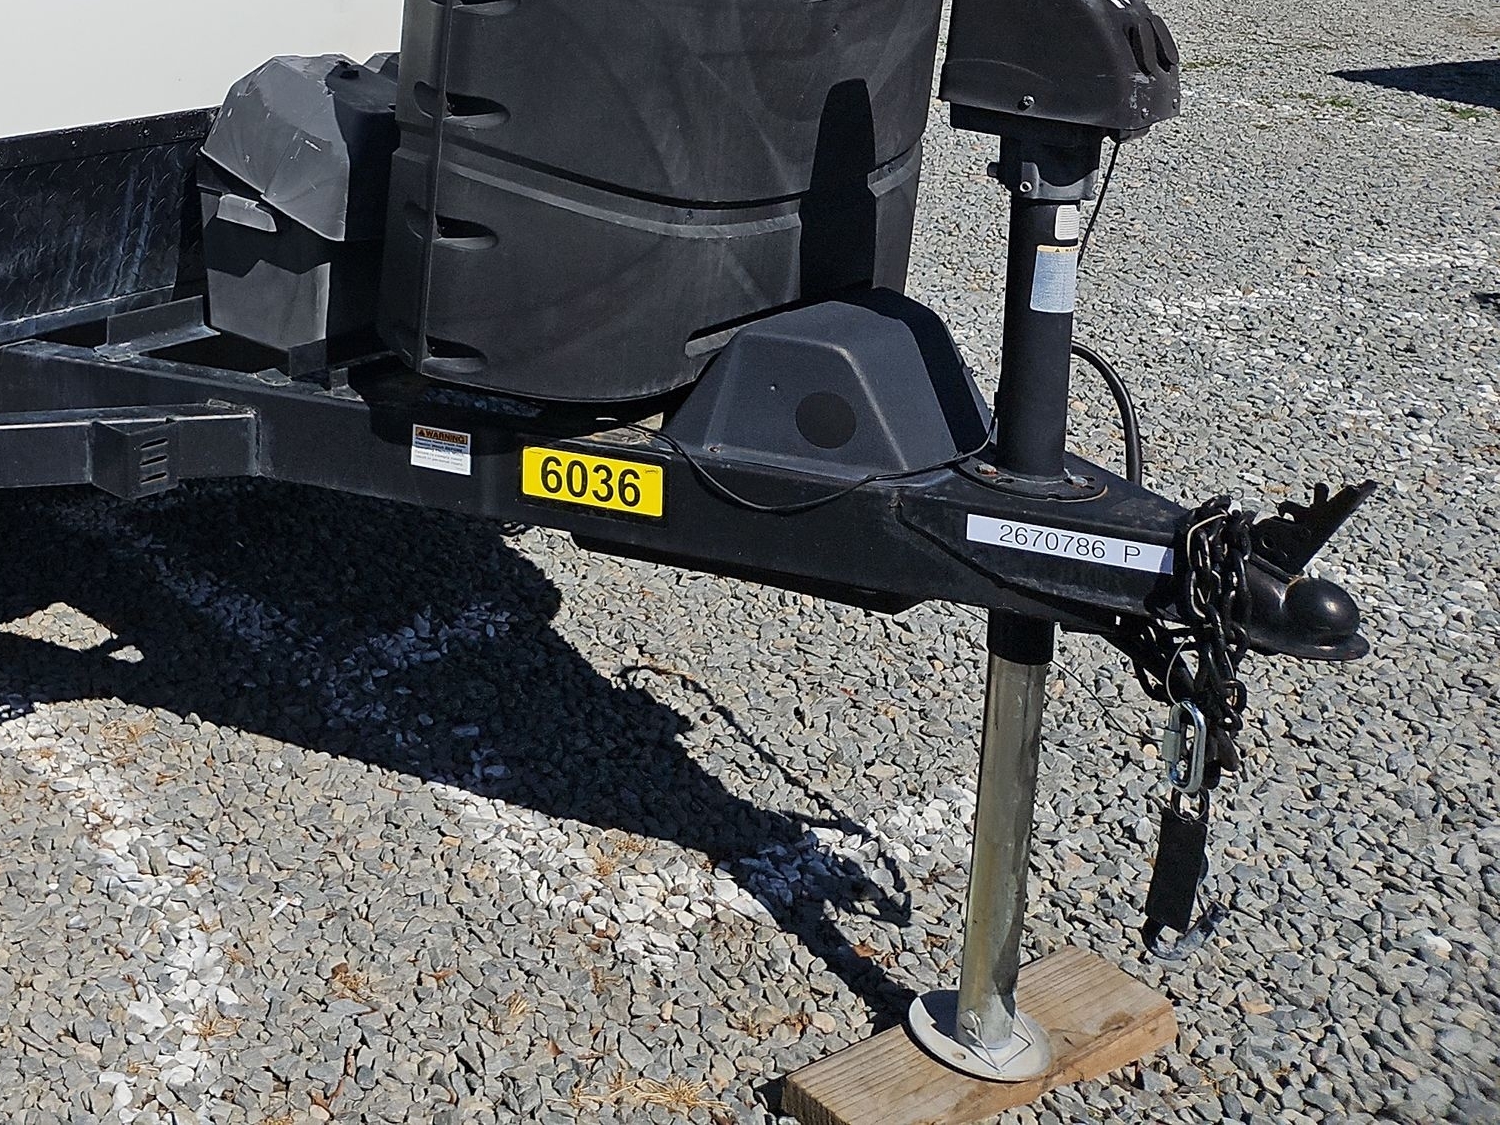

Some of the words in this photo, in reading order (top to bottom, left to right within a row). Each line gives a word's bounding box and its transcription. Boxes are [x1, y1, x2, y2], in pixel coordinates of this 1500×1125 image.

[425, 429, 465, 444] WARNING
[540, 455, 642, 507] 6036
[998, 524, 1107, 560] 2670786
[1123, 545, 1141, 563] P
